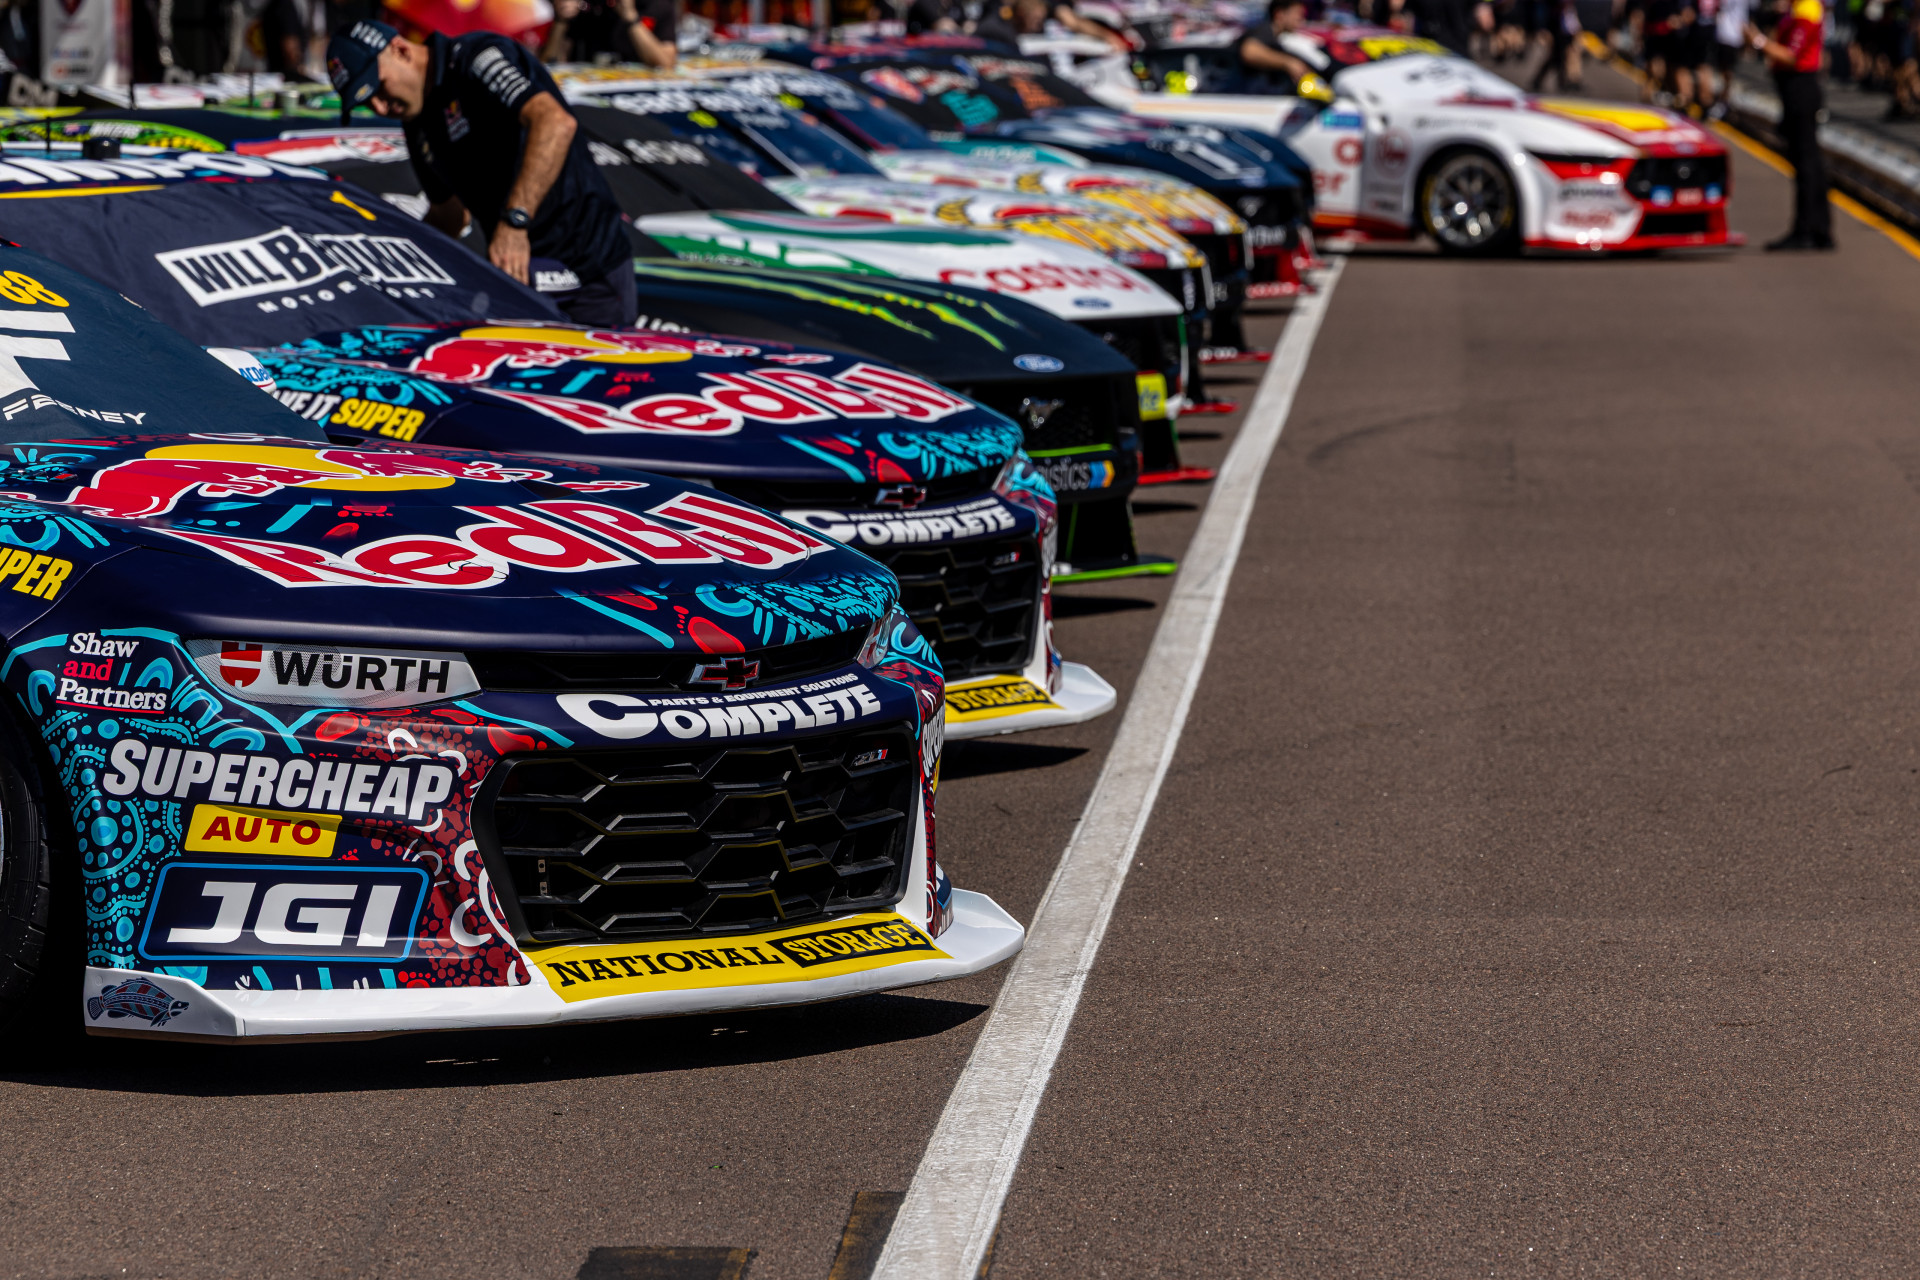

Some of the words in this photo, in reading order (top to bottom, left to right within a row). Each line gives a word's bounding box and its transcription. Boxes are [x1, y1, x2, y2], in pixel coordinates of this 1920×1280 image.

[171, 247, 291, 294] WILL
[2, 394, 146, 424] FEENEY
[330, 398, 425, 442] SUPER
[780, 504, 1016, 546] COMPLETE
[69, 632, 139, 658] Shaw
[62, 658, 114, 681] and
[648, 696, 710, 706] PARTS
[711, 696, 725, 704] &
[724, 686, 801, 702] EQUIPMENT
[801, 673, 859, 692] SOLUTIONS
[56, 677, 167, 711] Partners
[556, 687, 882, 740] COMPLETE
[103, 739, 454, 821] SUPERCHEAP
[202, 815, 322, 846] AUTO
[167, 881, 402, 948] JGI
[546, 946, 786, 987] NATIONAL
[783, 923, 927, 961] STORAGE
